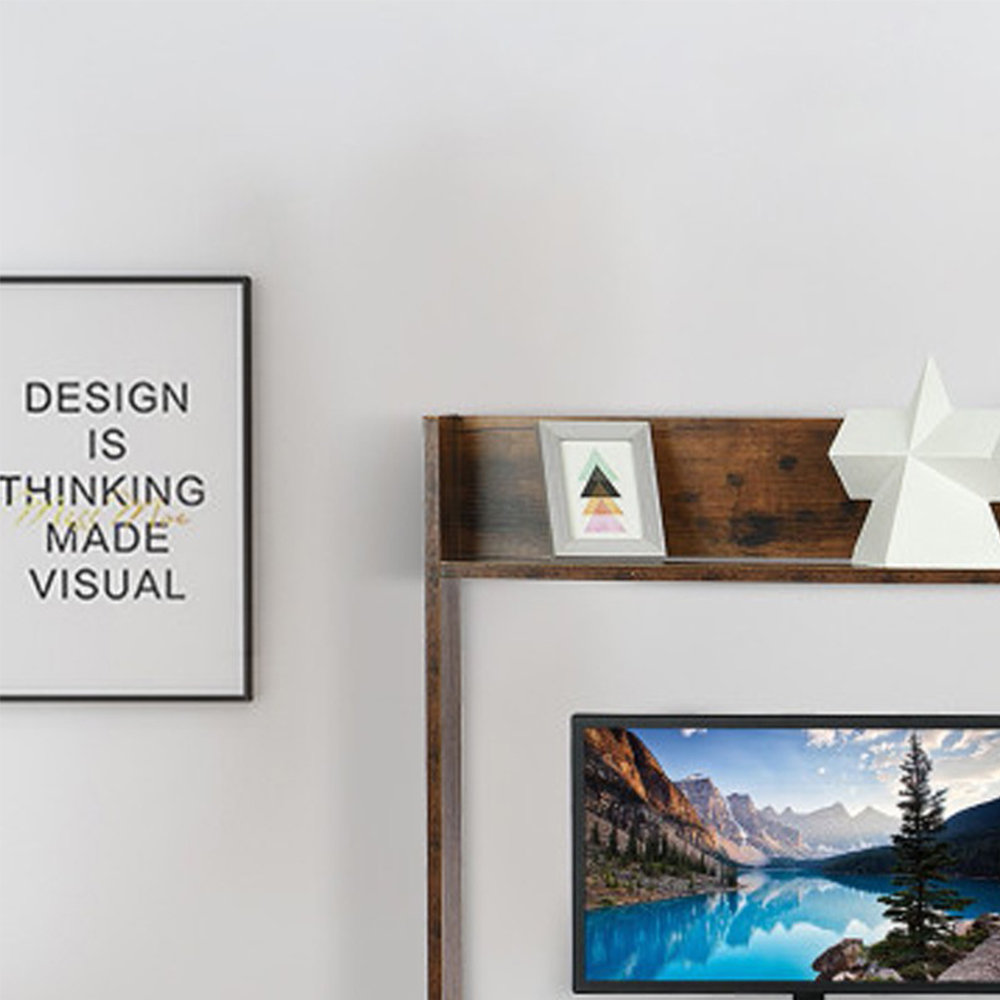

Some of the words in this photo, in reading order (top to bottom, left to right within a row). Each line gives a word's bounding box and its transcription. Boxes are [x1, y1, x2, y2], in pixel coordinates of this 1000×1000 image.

[25, 381, 188, 413] DESIGN
[88, 428, 127, 460] IS
[0, 475, 206, 506] THINKING
[46, 521, 169, 553] MADE
[28, 568, 186, 600] VISUAL
